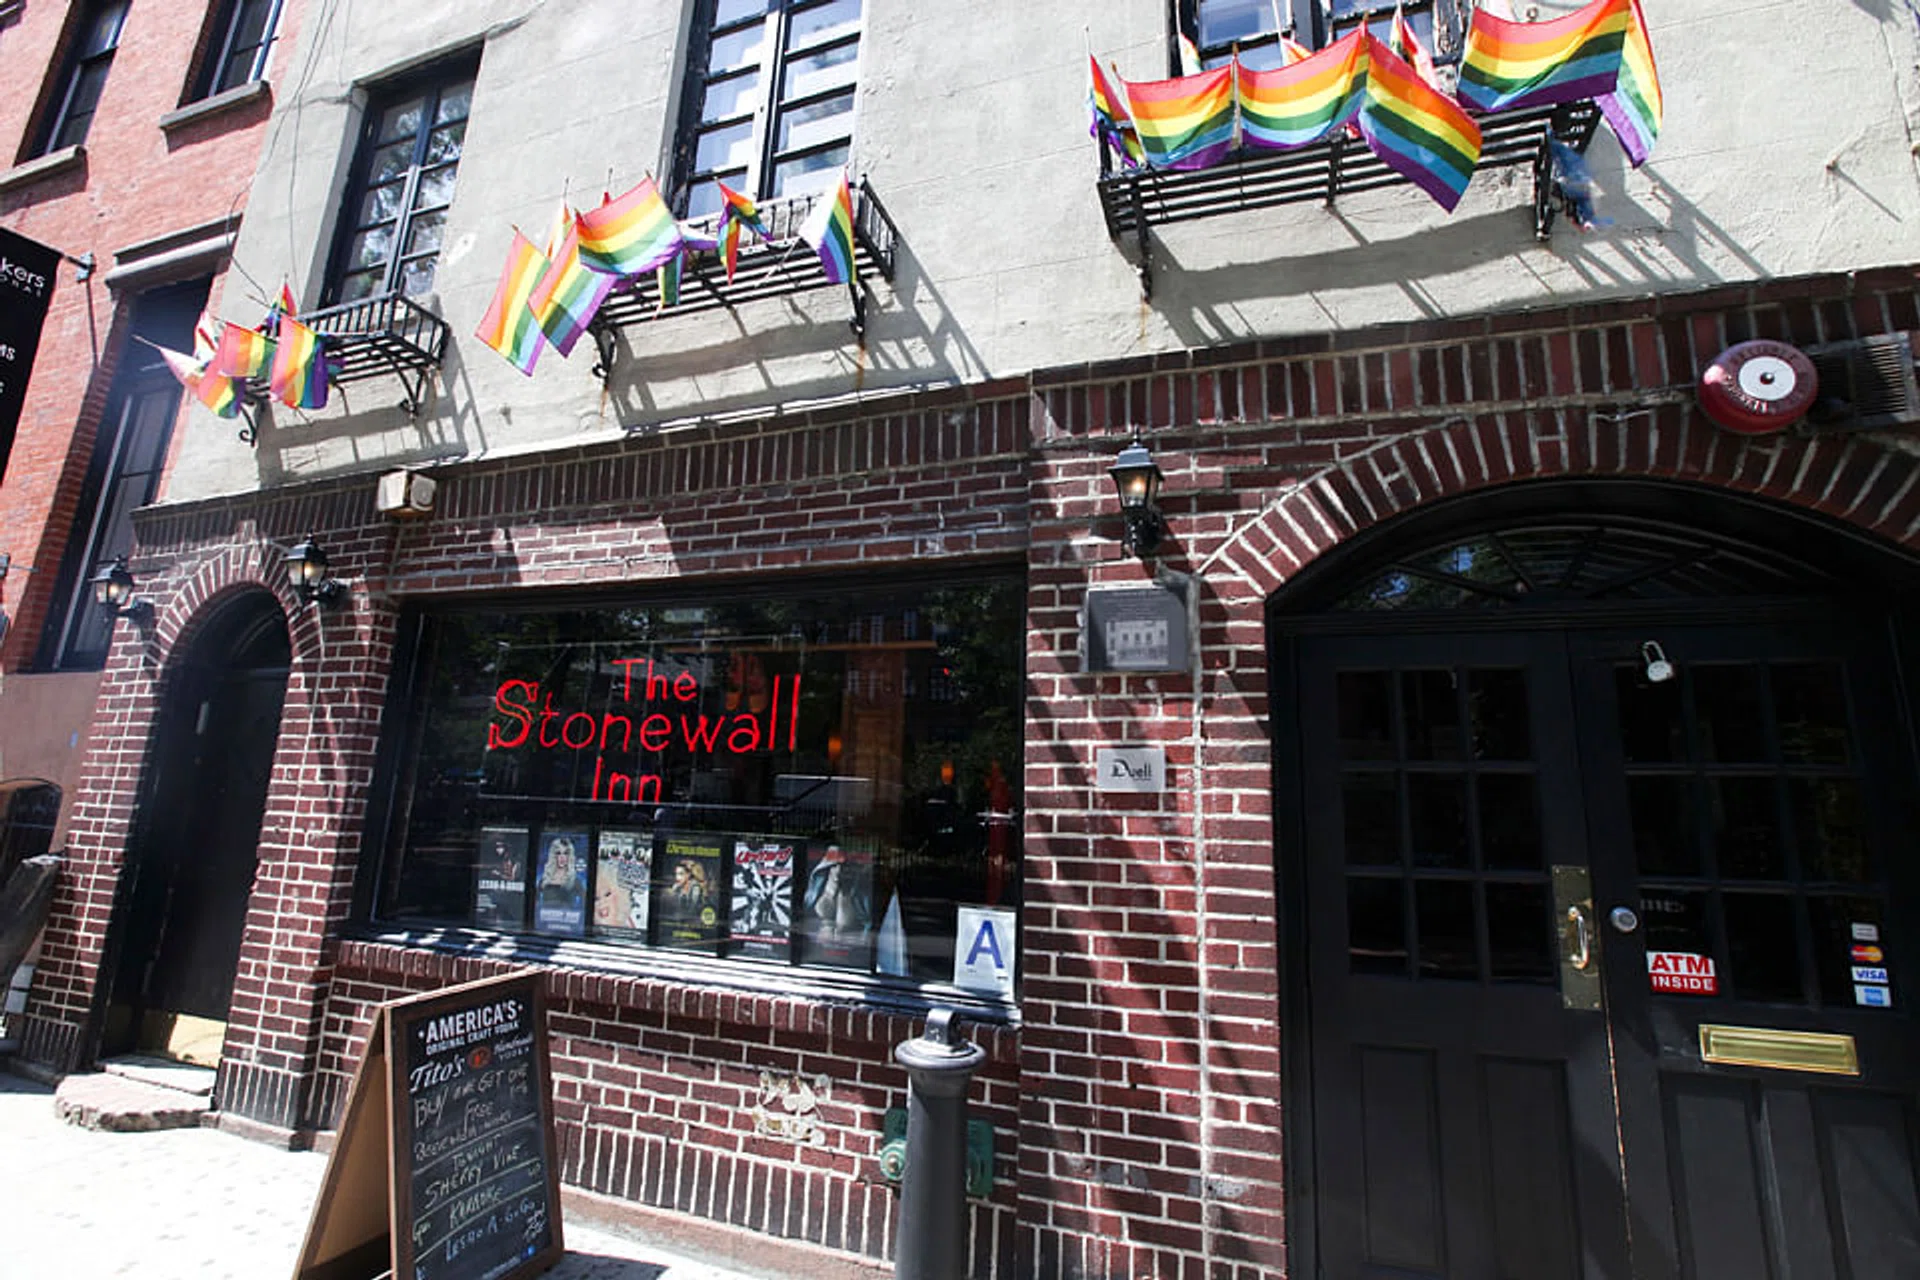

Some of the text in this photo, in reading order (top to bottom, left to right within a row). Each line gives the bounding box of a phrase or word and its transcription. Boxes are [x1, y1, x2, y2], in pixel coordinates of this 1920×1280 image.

[611, 658, 698, 701] The
[488, 673, 800, 753] Stonewall
[593, 757, 662, 804] Inn
[966, 920, 1005, 968] A
[1651, 953, 1711, 975] ATM
[1652, 976, 1714, 991] INSIDE
[1856, 969, 1887, 979] VISA
[425, 1000, 517, 1043] AMERICA'S
[426, 1036, 466, 1055] ORIGINAL
[467, 1027, 492, 1043] CRAFT
[409, 1053, 465, 1093] Tito's
